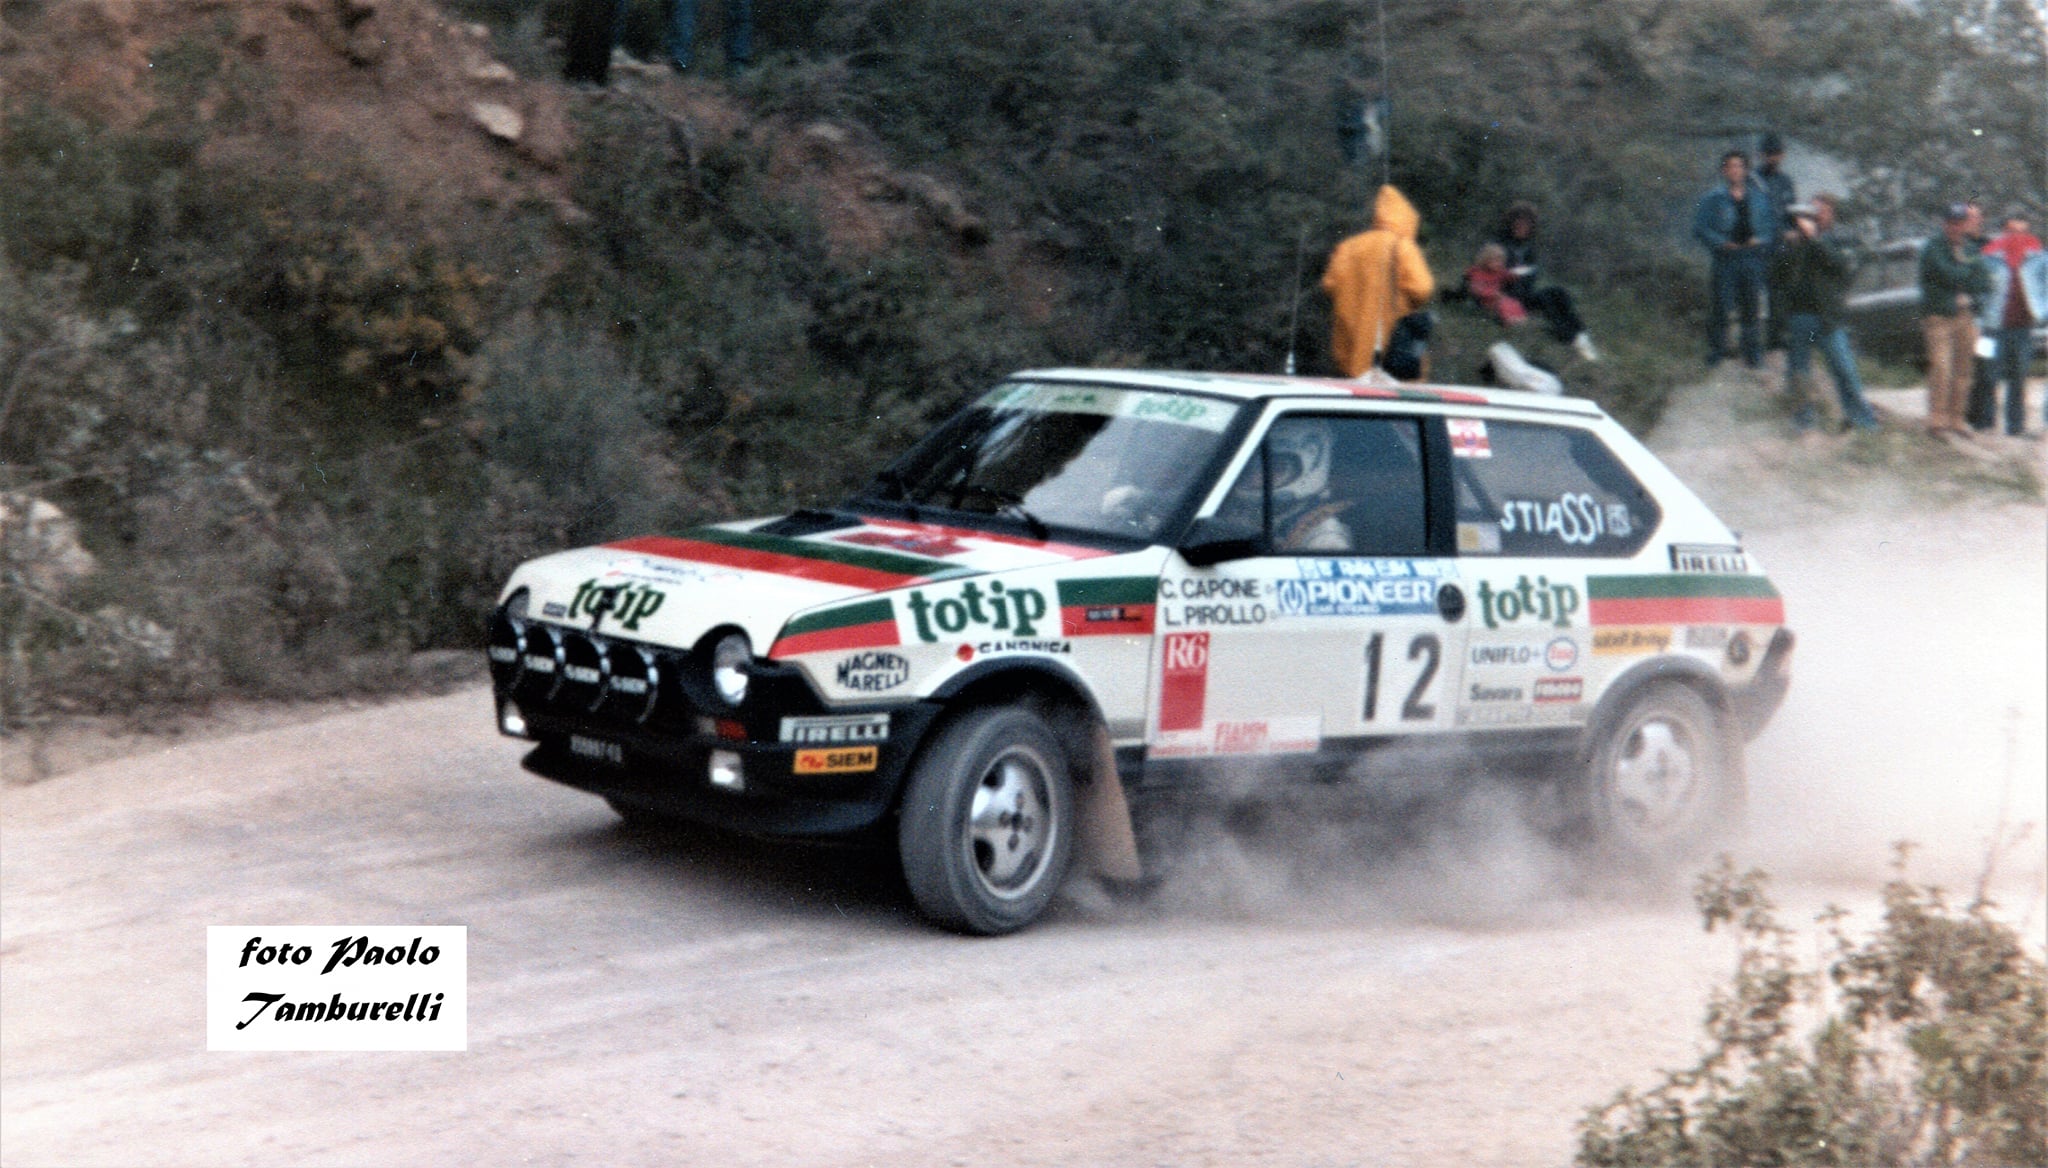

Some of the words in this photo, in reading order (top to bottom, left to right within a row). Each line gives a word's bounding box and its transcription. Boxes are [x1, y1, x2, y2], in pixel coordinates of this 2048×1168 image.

[1501, 492, 1603, 543] STIASSI
[1668, 543, 1748, 571] PIRELLI
[1182, 578, 1259, 598] CAPONE
[1308, 579, 1435, 604] PIONEER
[1478, 575, 1578, 629] totip
[908, 580, 1046, 642] totip
[1185, 603, 1266, 624] PIROLLO
[1166, 634, 1207, 669] R6
[1363, 631, 1441, 721] 12
[779, 713, 890, 742] PIRELLI
[826, 752, 873, 768] SIEM
